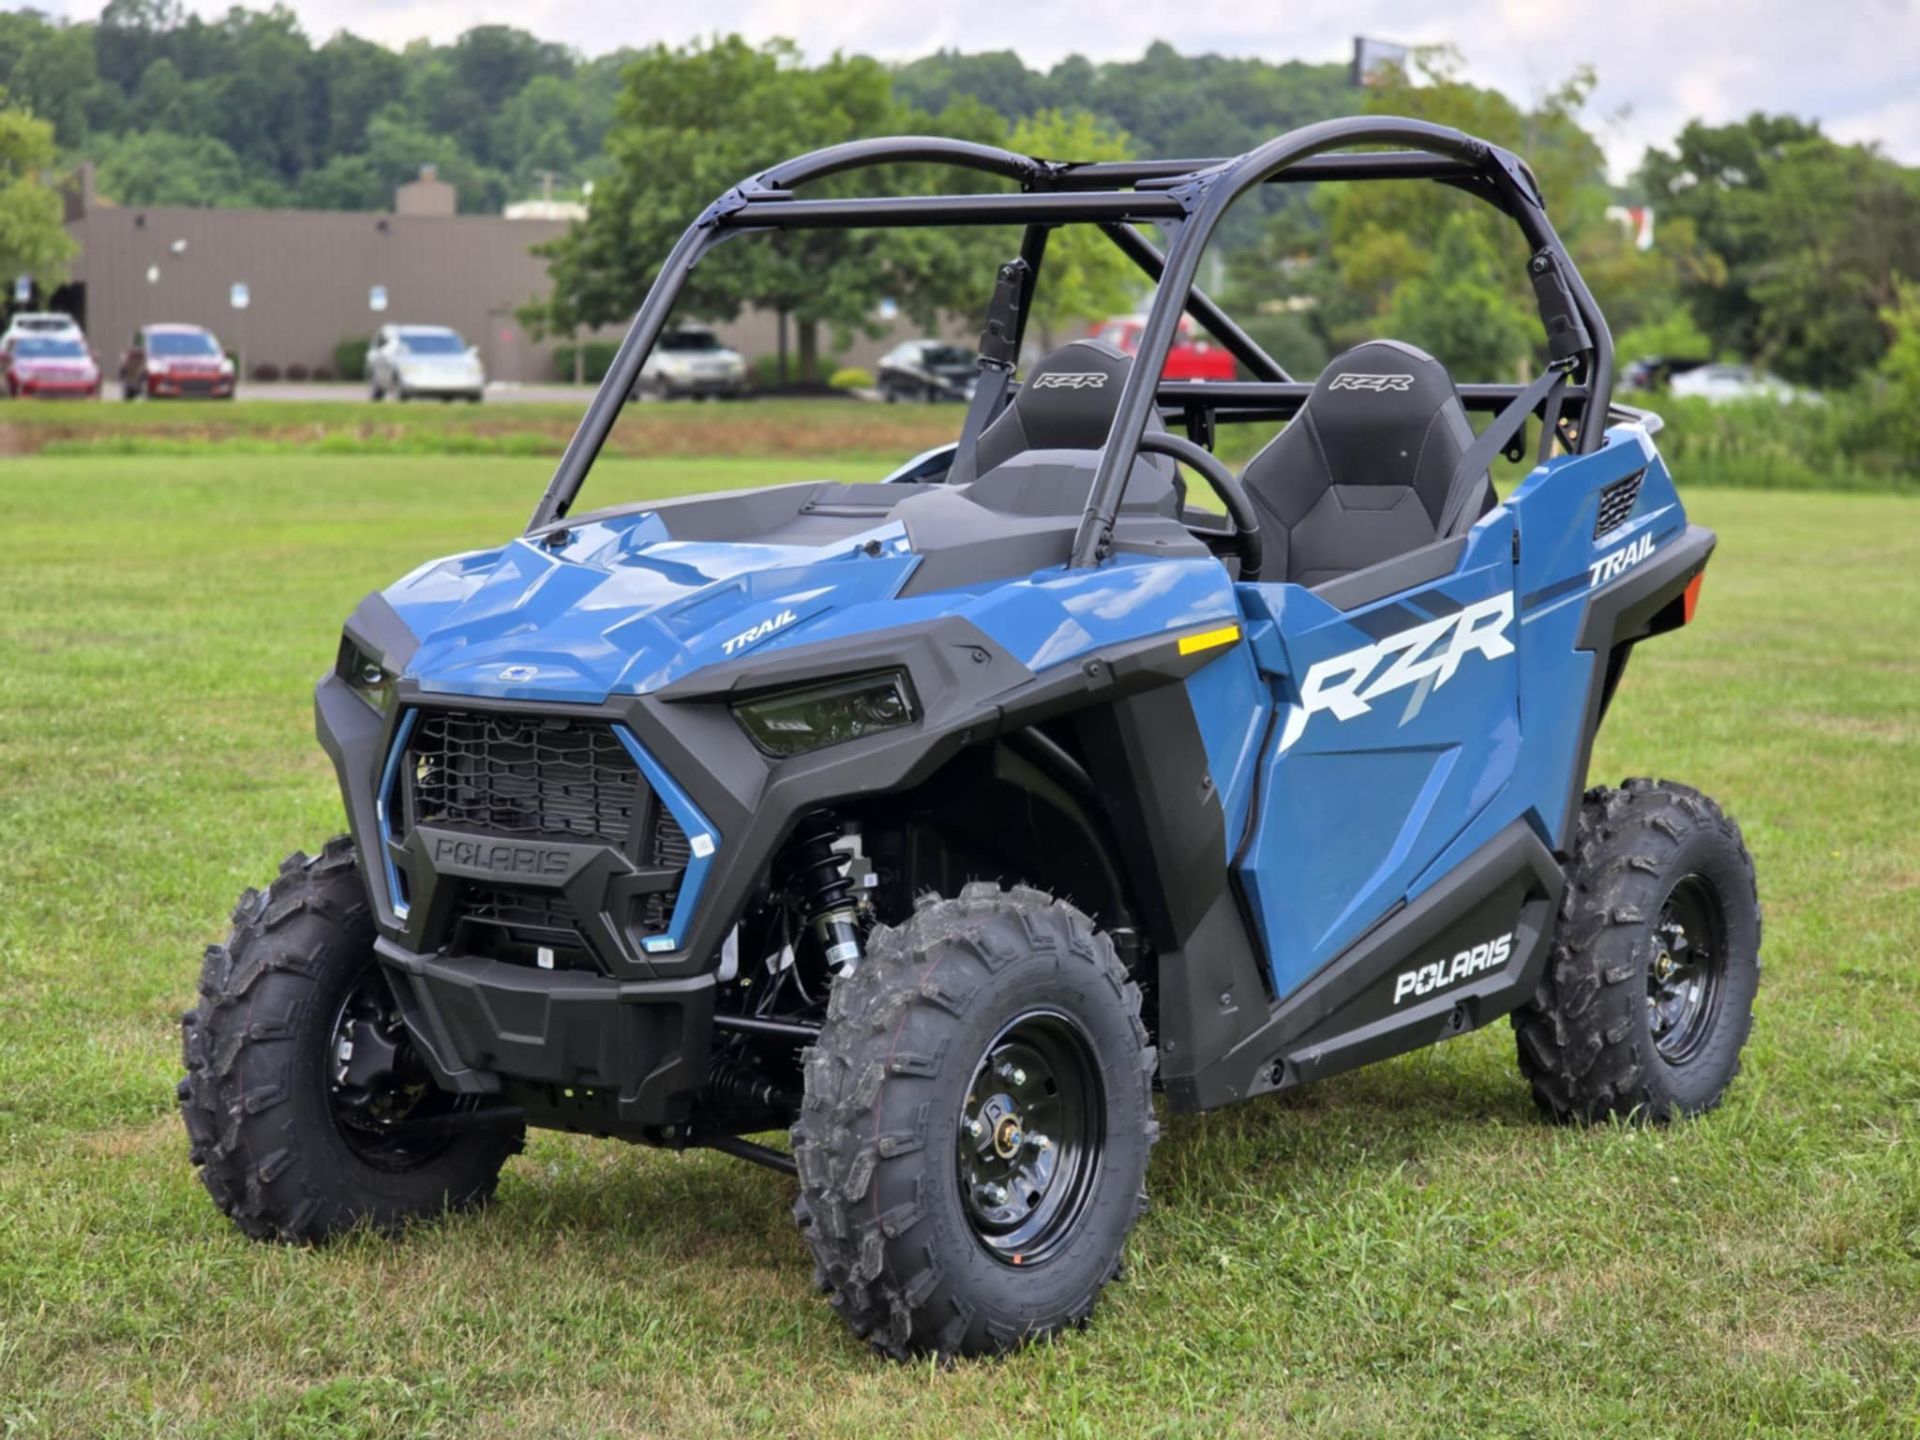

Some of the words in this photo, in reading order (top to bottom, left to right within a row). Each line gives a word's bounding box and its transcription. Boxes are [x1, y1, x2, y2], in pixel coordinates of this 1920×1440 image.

[1032, 372, 1109, 389] RZR
[1328, 372, 1415, 392] RZR
[1588, 531, 1656, 588] TRAIL
[721, 609, 797, 655] TRAIL
[1278, 589, 1515, 754] RZR
[435, 838, 571, 875] POLARIS
[1393, 932, 1513, 1005] POLARIS
